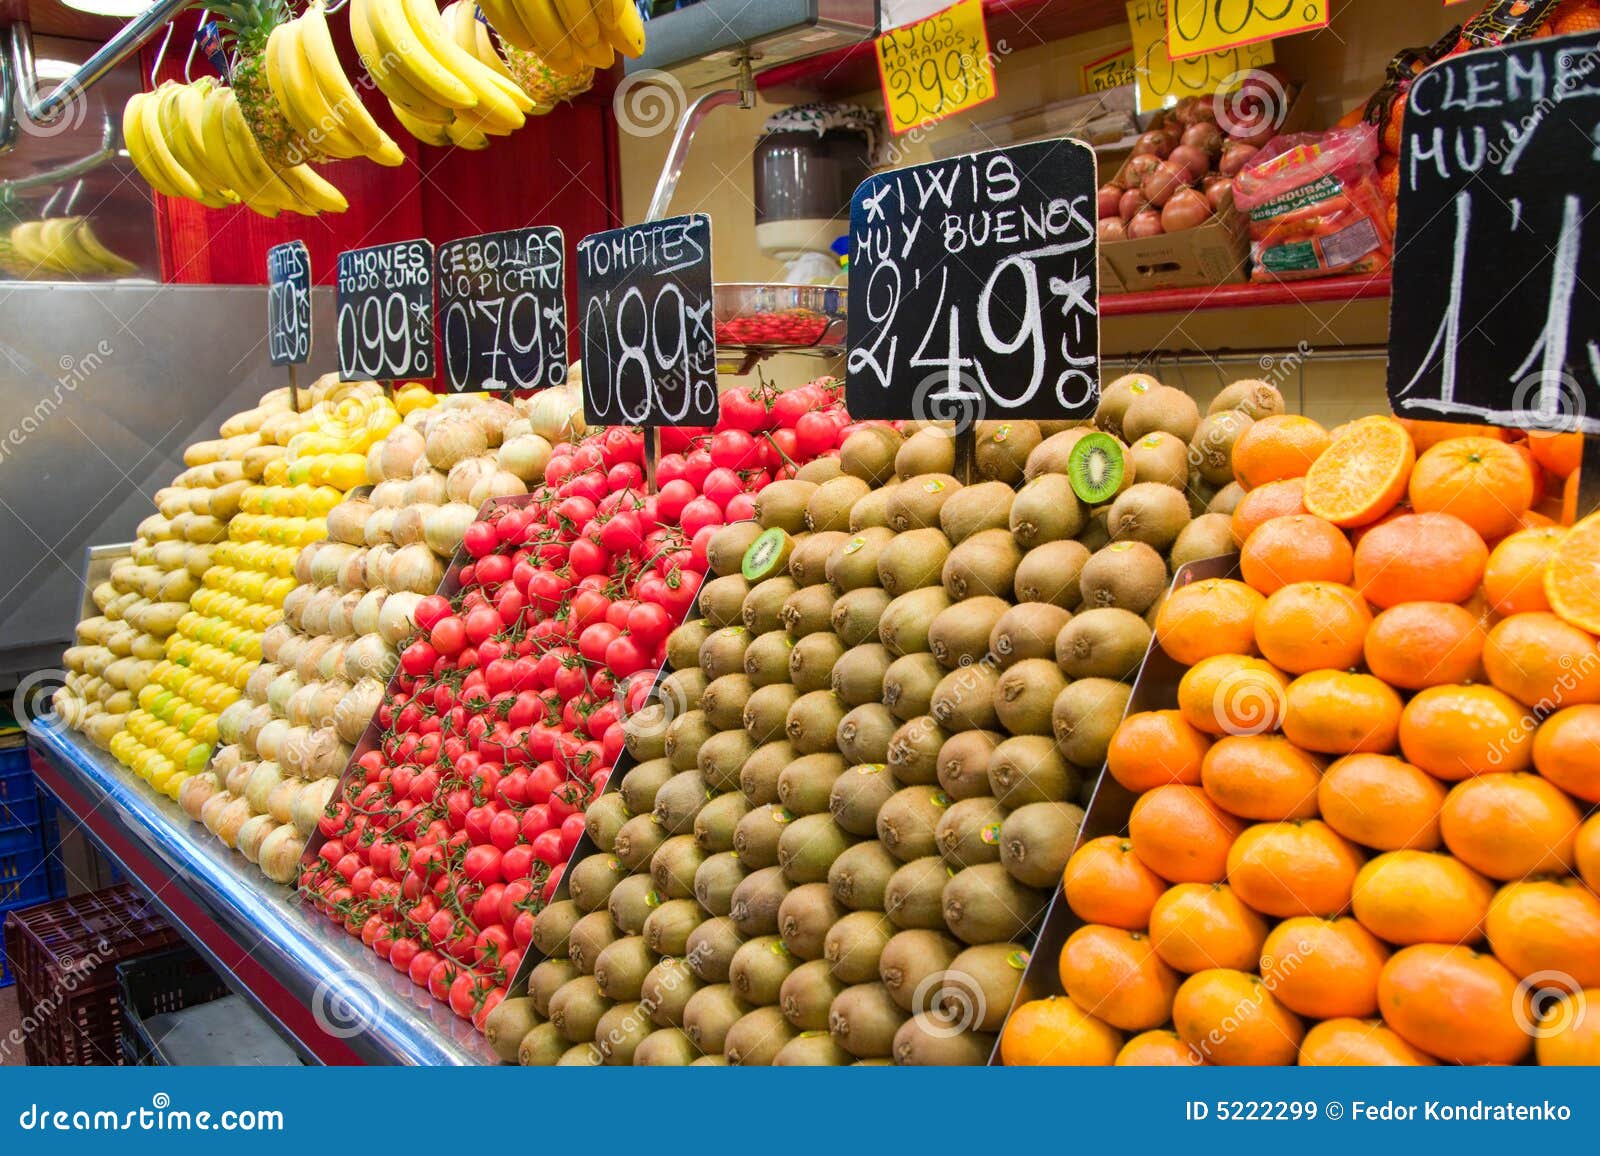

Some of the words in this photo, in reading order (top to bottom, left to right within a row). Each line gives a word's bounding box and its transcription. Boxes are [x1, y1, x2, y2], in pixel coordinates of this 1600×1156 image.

[881, 12, 954, 59] AJOS
[1410, 110, 1542, 192] MUY
[440, 230, 562, 274] CEBOLLAS
[577, 220, 705, 277] TOMATES
[854, 214, 922, 266] MUY
[939, 195, 1096, 258] BUENOS
[338, 272, 379, 294] TODO
[384, 266, 430, 288] ZUMO
[339, 243, 425, 277] LIMONES
[440, 275, 471, 297] NO
[337, 291, 412, 379] 0'99
